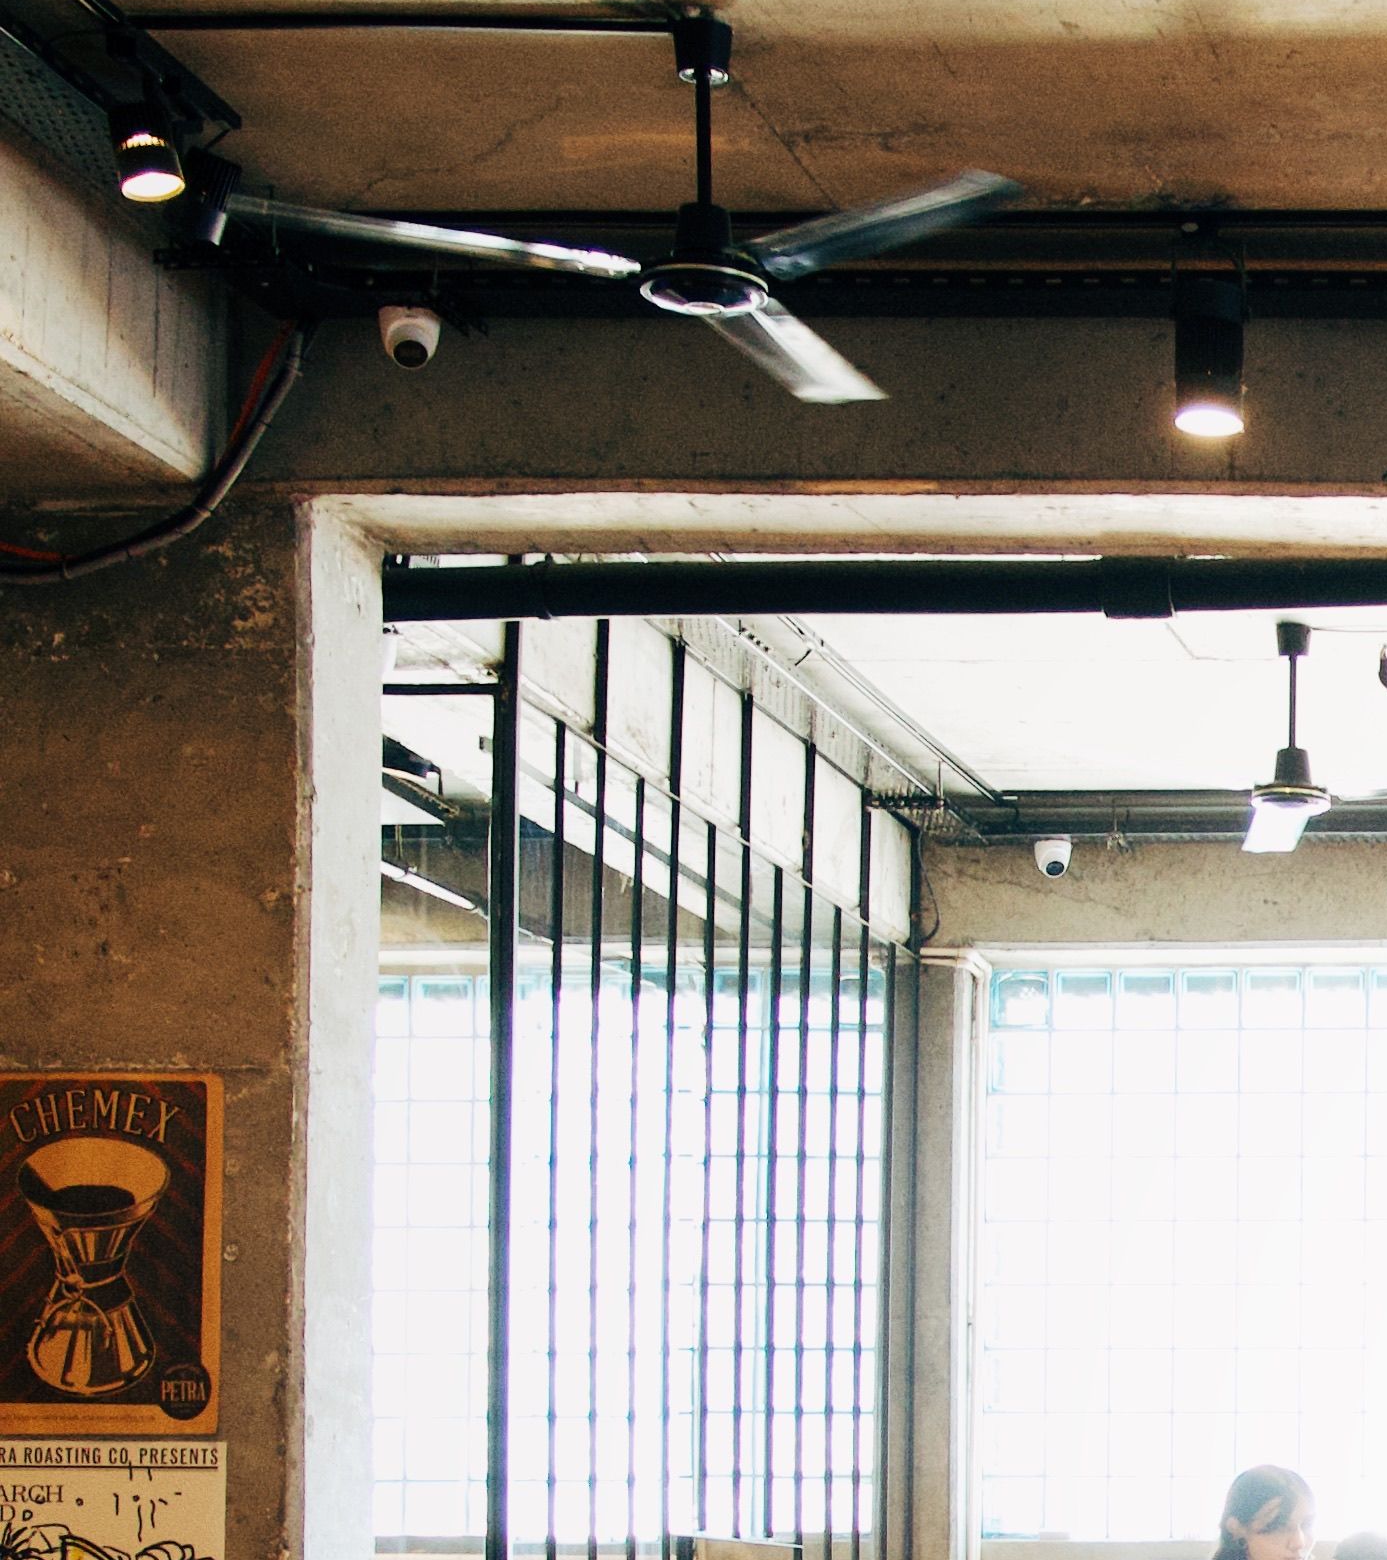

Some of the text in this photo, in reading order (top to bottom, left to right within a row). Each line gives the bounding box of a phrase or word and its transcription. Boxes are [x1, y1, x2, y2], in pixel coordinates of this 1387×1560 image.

[10, 1089, 183, 1143] CHEMEX
[160, 1380, 206, 1402] PETRA
[23, 1447, 101, 1465] ROASTING
[139, 1447, 219, 1465] PRESENTS
